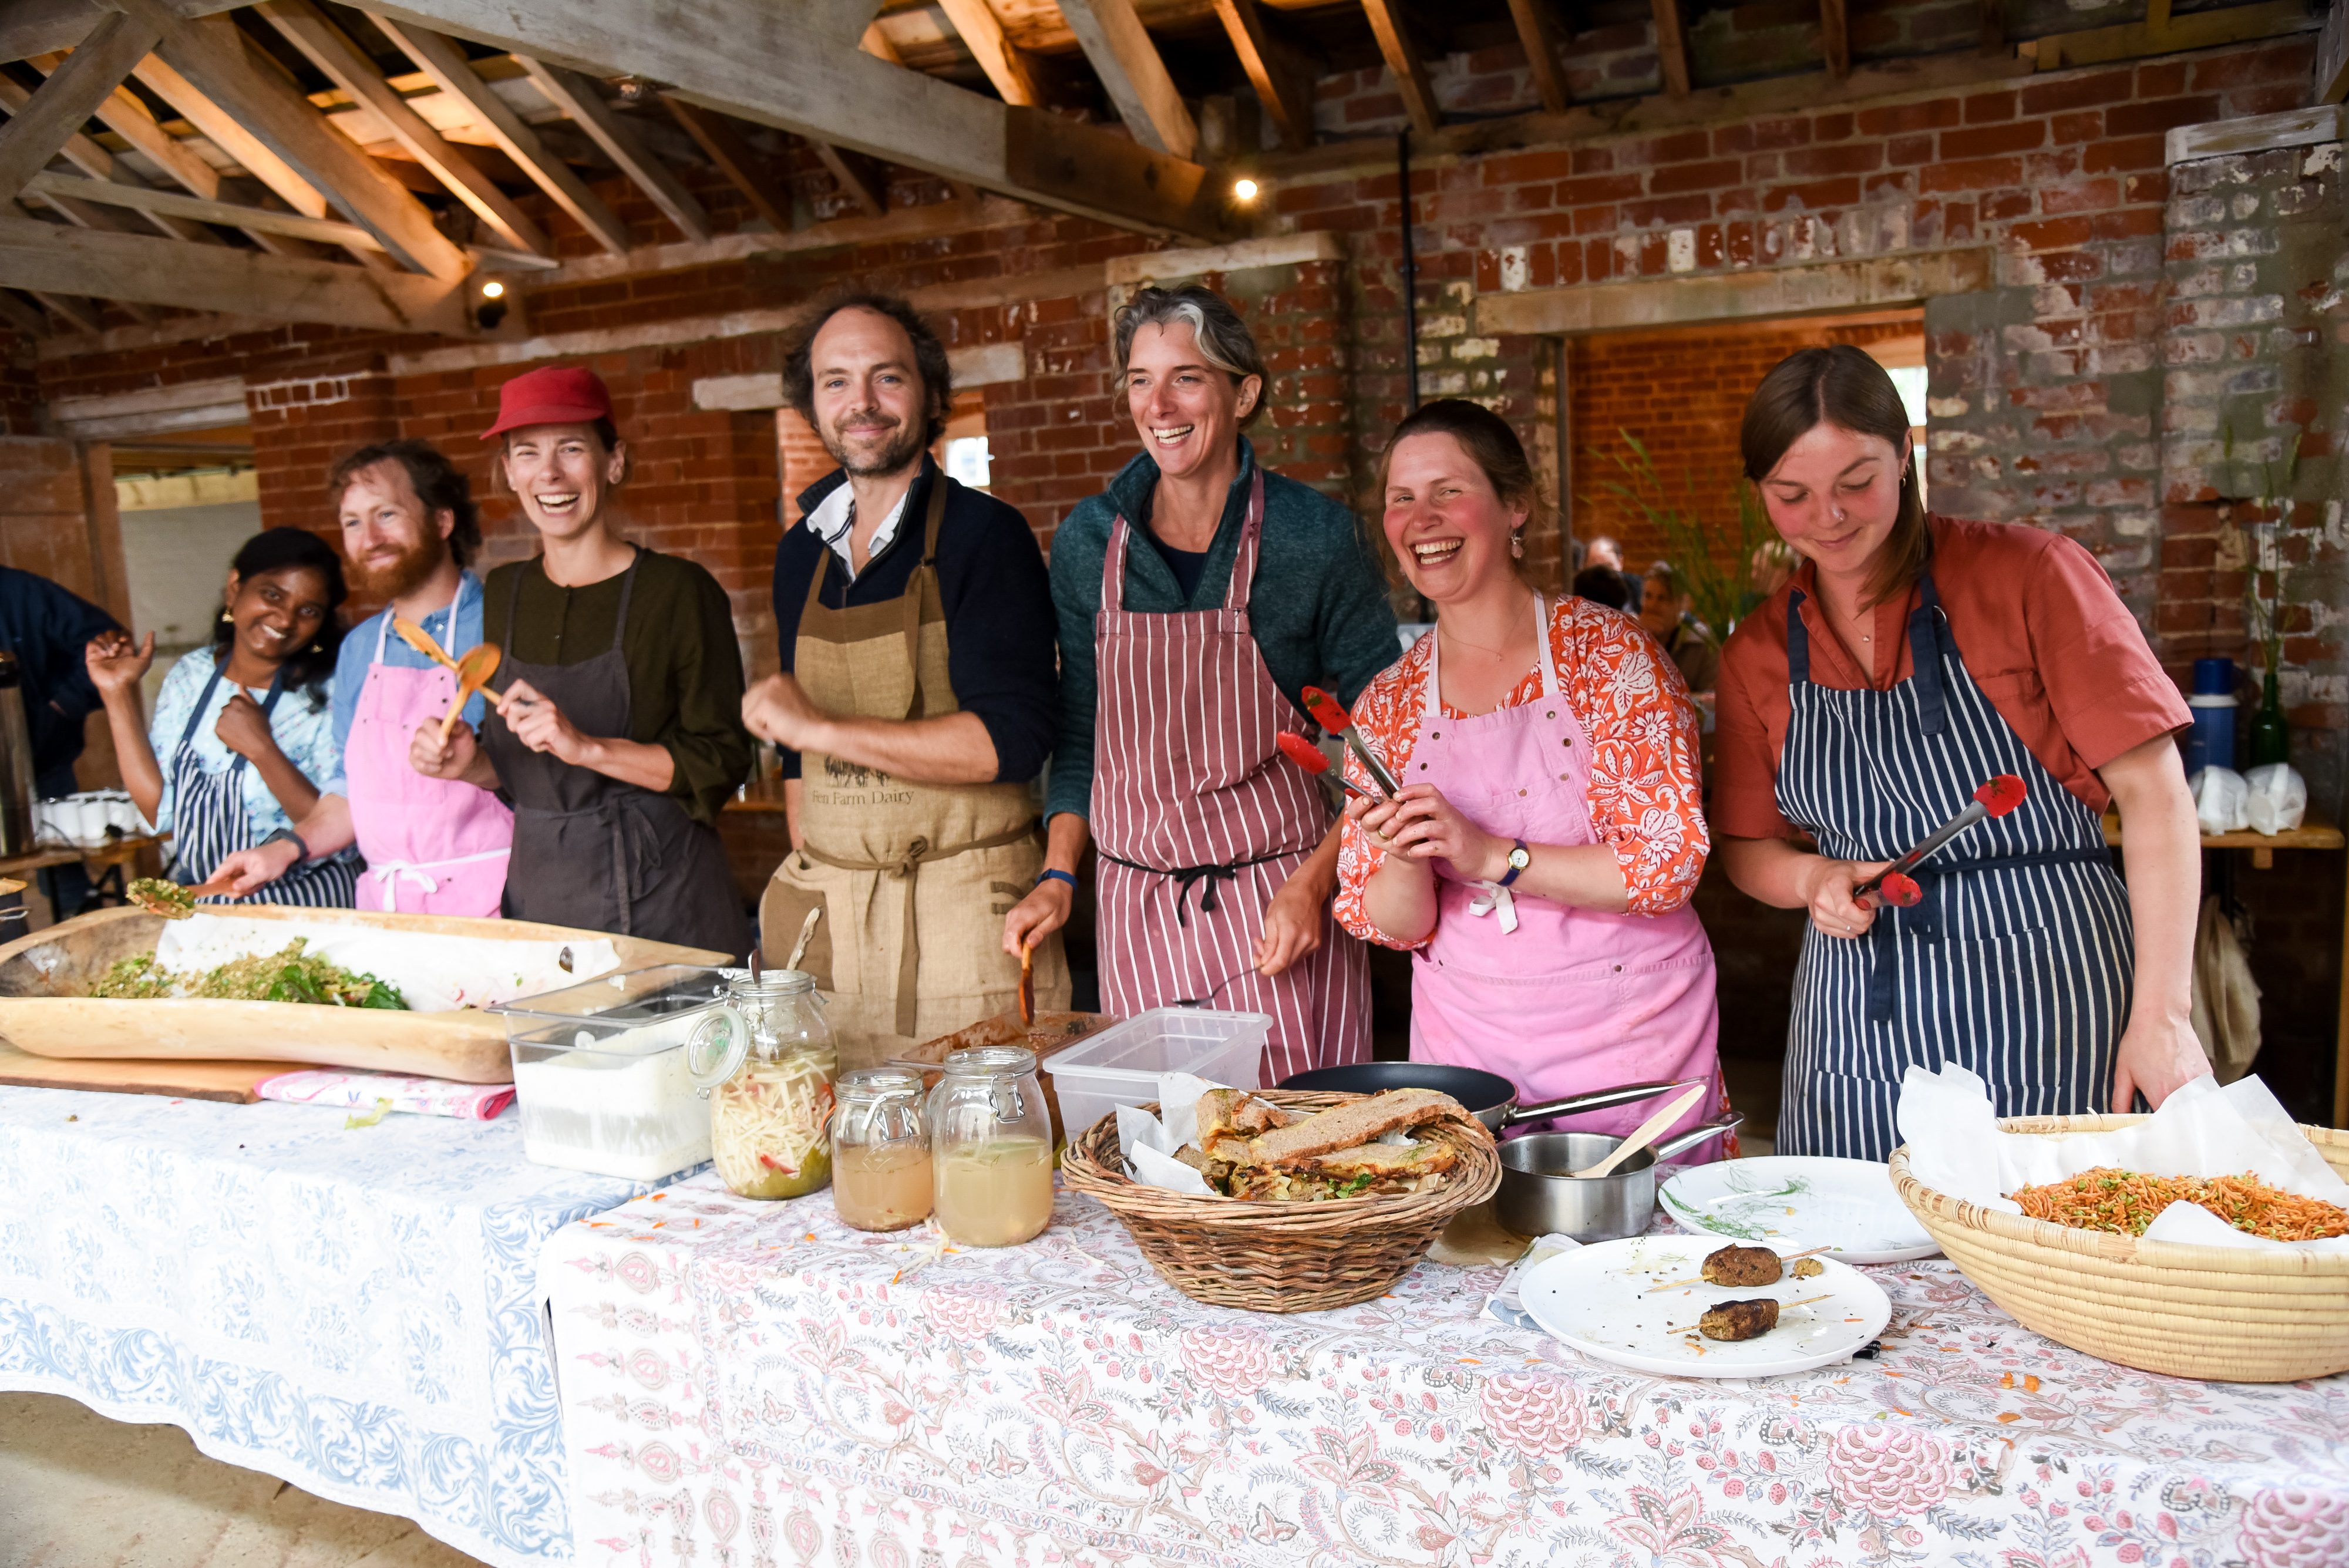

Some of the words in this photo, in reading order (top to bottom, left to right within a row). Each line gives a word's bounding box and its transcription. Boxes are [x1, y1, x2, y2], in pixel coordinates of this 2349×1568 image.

[813, 790, 829, 804] Fen
[833, 791, 866, 805] Farm
[871, 789, 915, 805] Dairy
